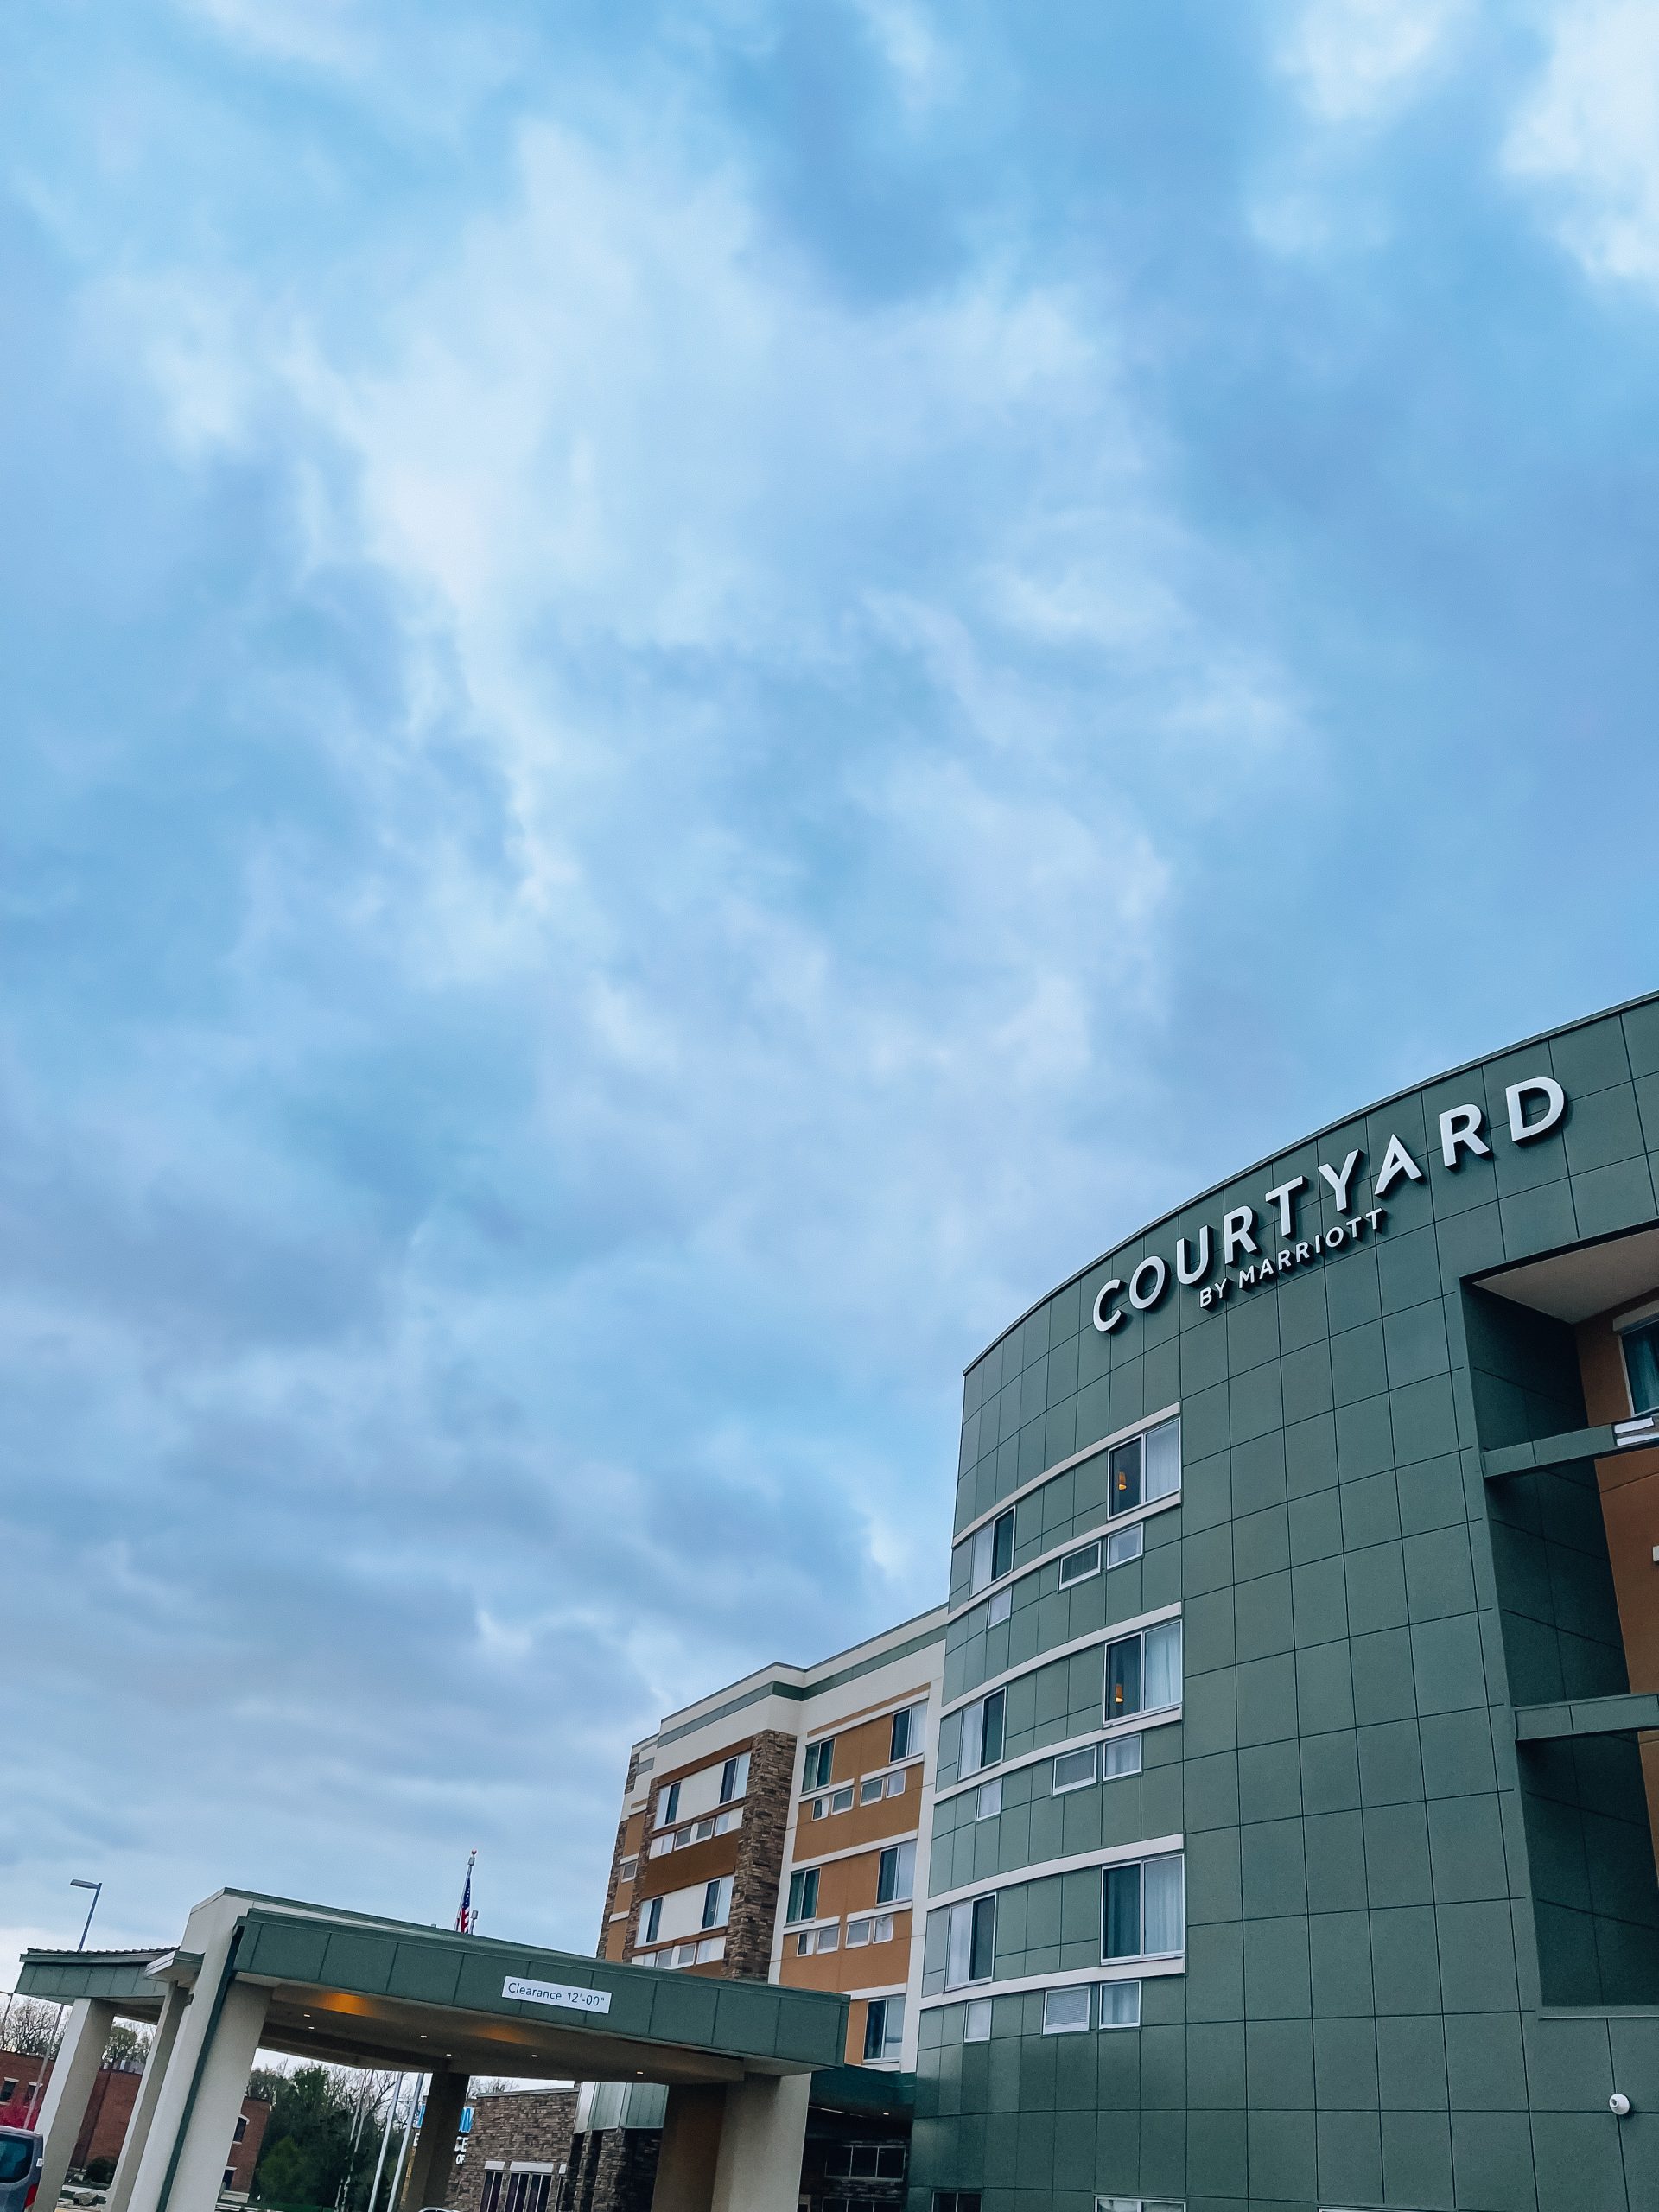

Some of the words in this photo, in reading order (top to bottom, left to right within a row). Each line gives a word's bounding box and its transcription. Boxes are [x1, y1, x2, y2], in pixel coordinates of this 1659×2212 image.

[1092, 1077, 1565, 1333] COURTYARD
[1199, 1277, 1227, 1308] BY
[1238, 1207, 1382, 1289] MARRIOTT
[508, 1982, 562, 2000] Clearance
[567, 1992, 605, 2006] 12'-00"
